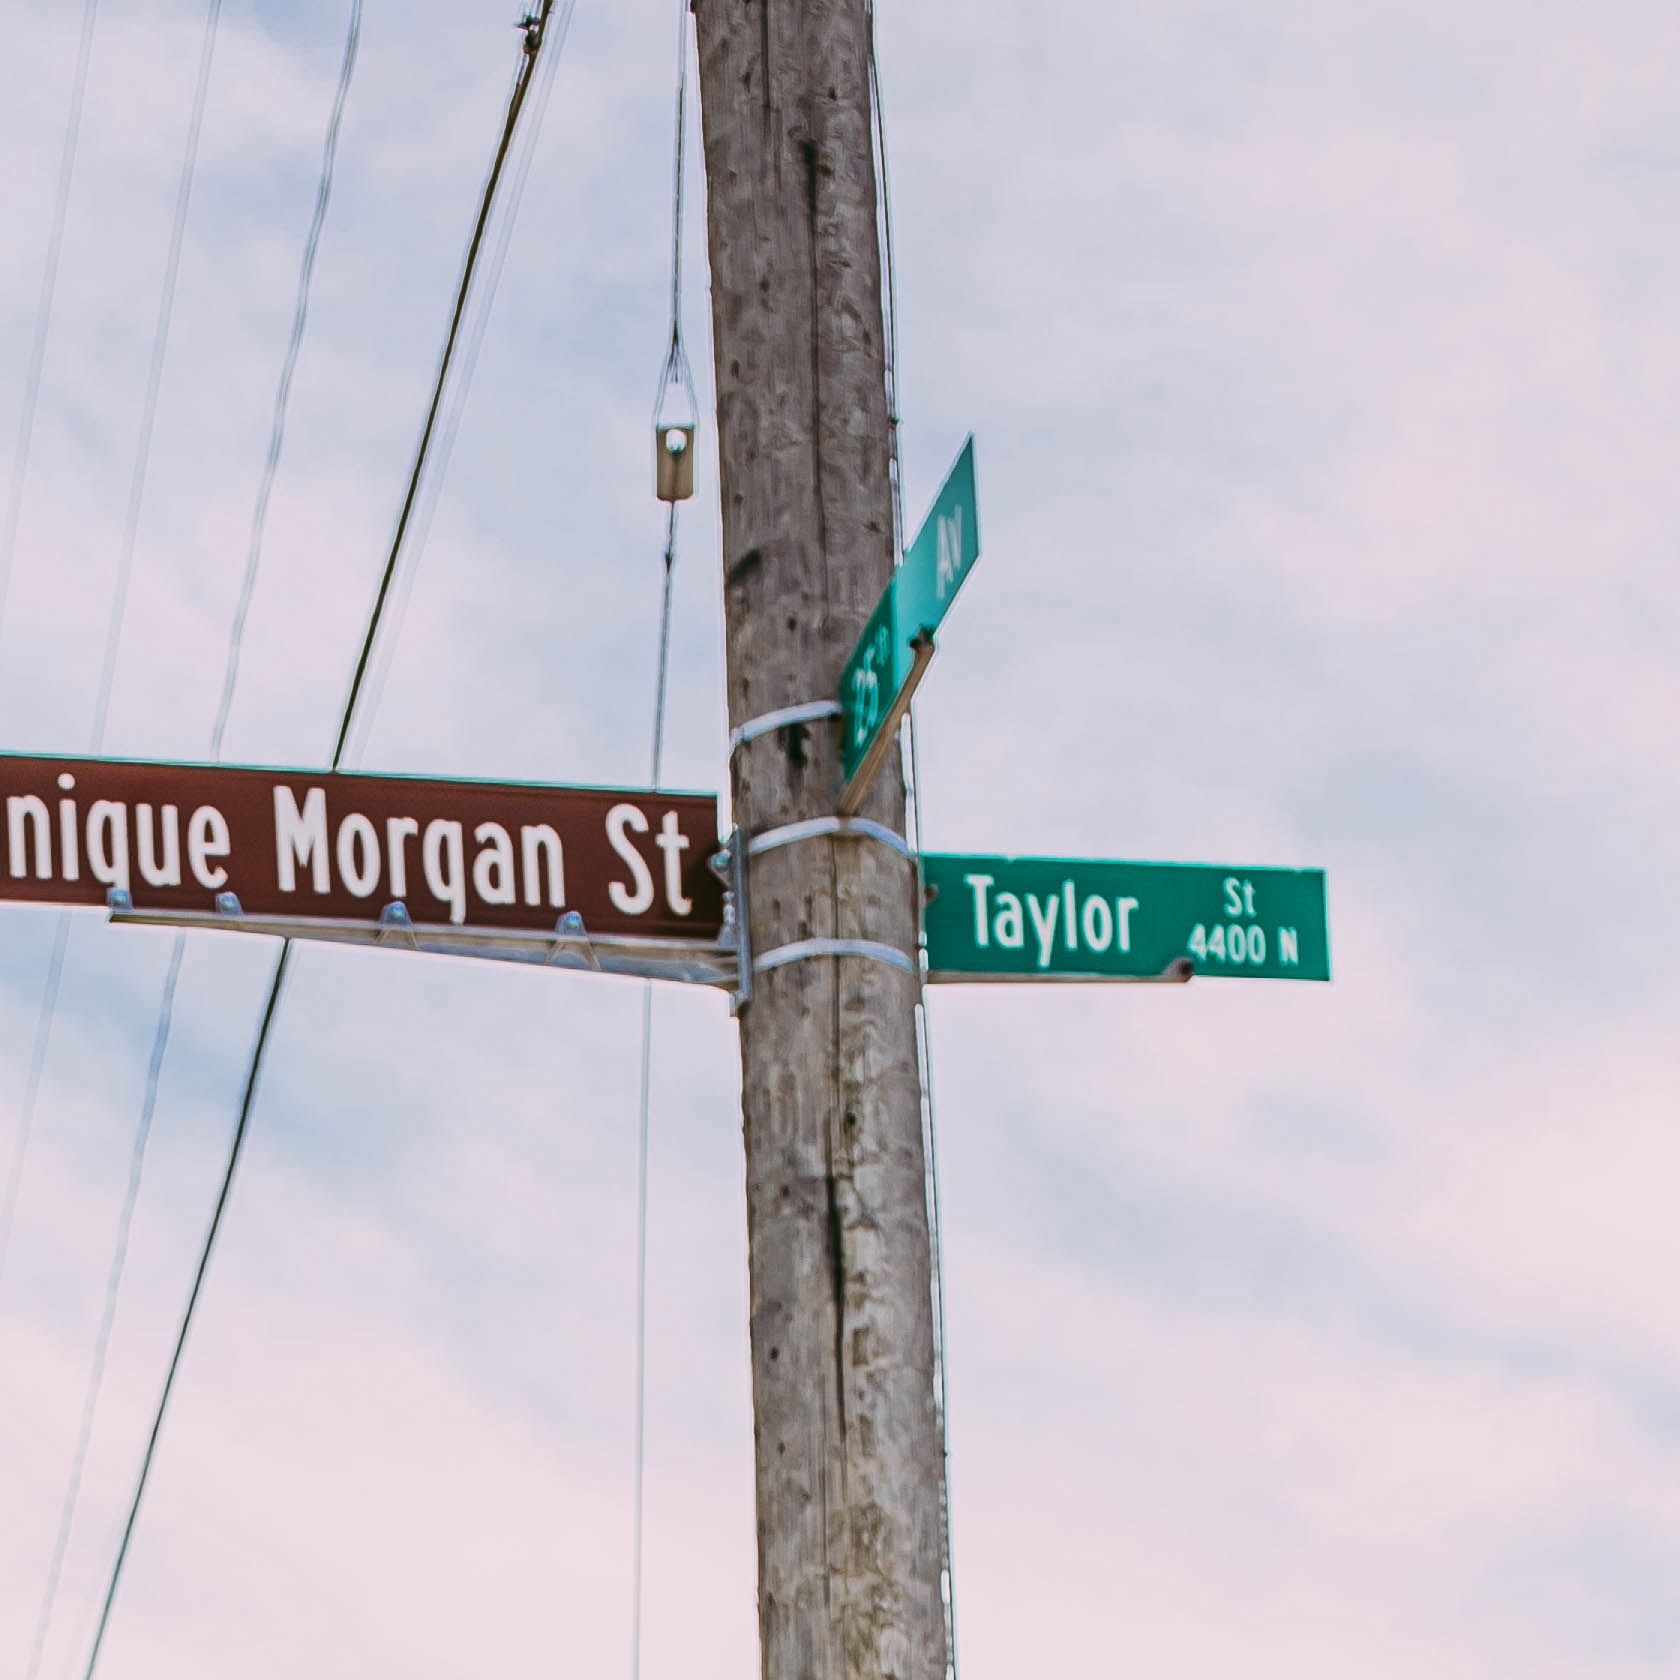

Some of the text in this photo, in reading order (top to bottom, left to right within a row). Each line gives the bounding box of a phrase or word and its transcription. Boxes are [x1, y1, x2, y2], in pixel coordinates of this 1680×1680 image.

[274, 785, 566, 924] Morgan
[605, 803, 693, 917] St
[965, 874, 1139, 968] Taylor
[1223, 877, 1256, 917] St
[1186, 923, 1299, 966] 4400 N
